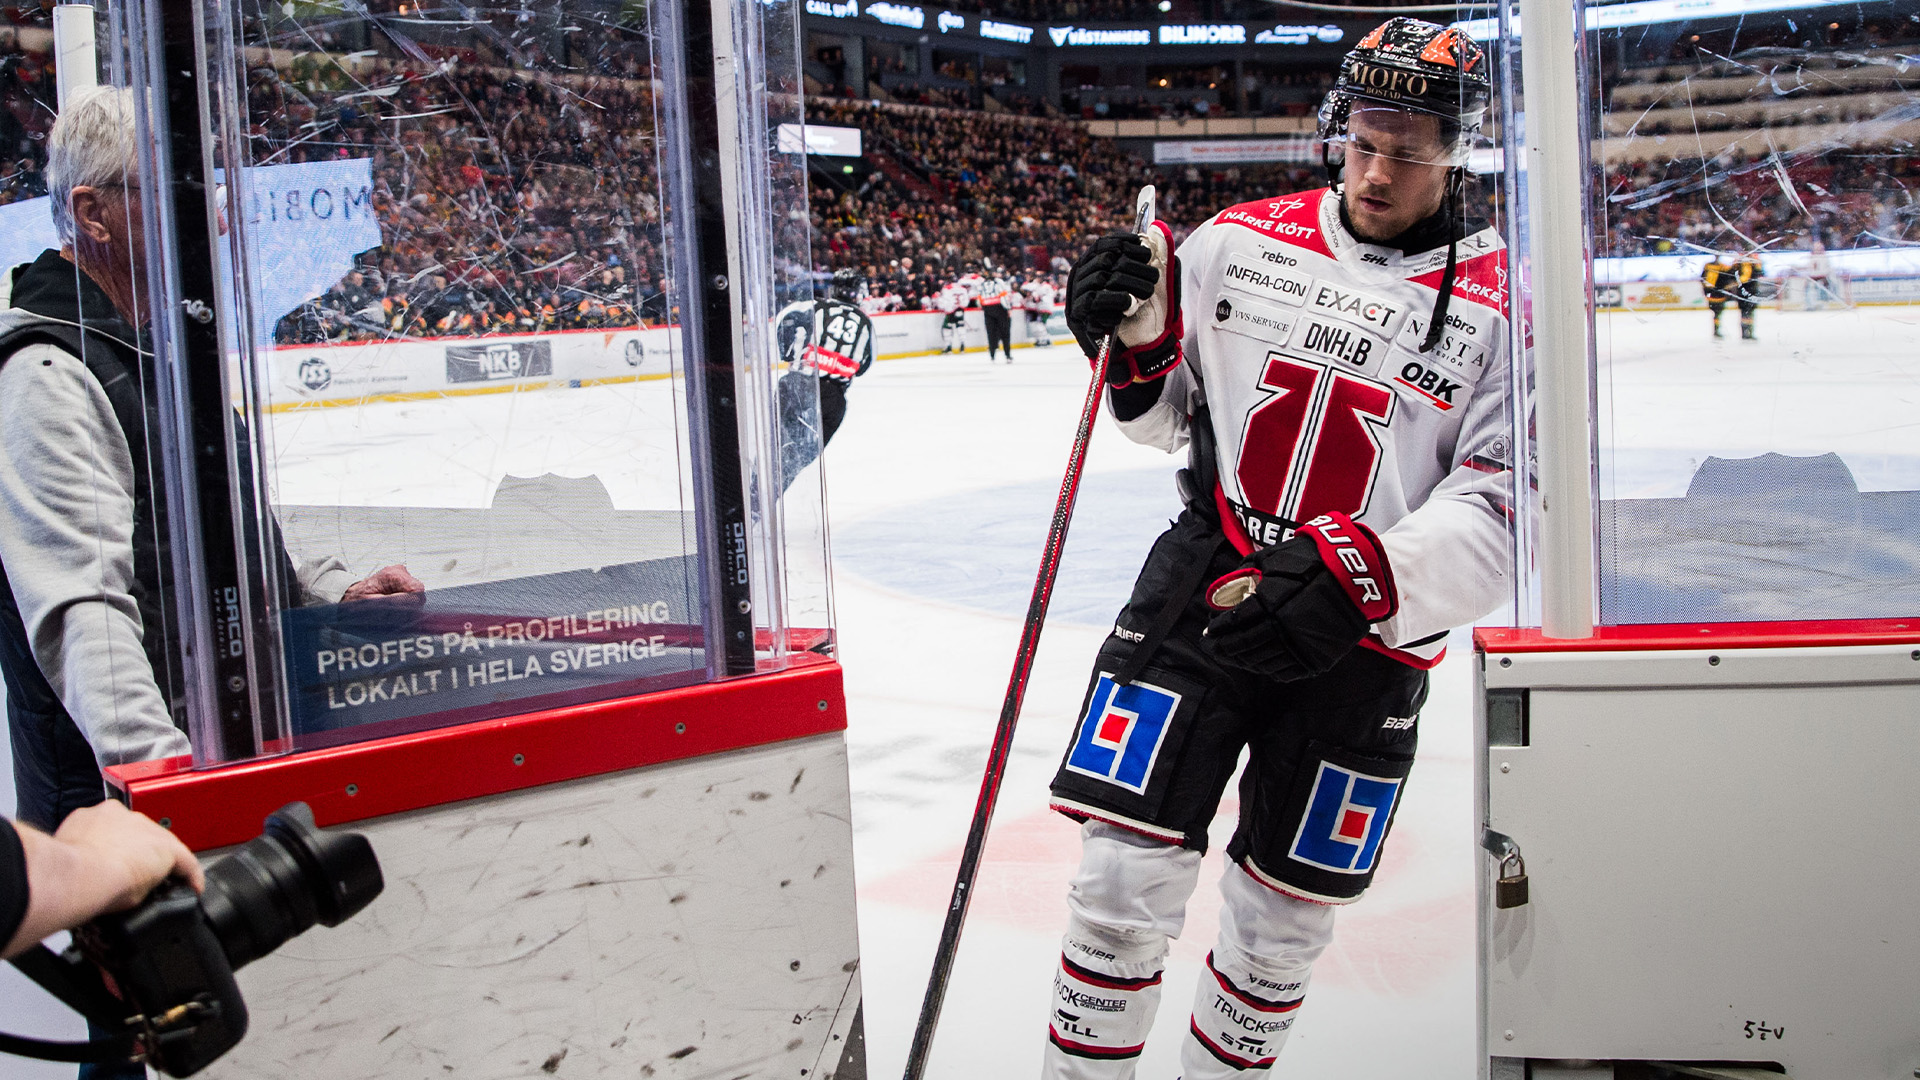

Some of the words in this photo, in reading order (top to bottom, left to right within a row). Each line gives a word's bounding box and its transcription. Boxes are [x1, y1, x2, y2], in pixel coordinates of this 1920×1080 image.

[1380, 52, 1418, 64] BAUER
[1349, 63, 1428, 96] MOFO
[1365, 86, 1401, 100] BOSTAD
[1223, 211, 1275, 231] NÄRKE
[1275, 221, 1316, 240] KÖTT
[1360, 253, 1389, 267] SHL
[1226, 263, 1307, 297] INFRA-CON
[1235, 310, 1250, 321] VVS
[1251, 315, 1290, 333] SERVICE
[1315, 286, 1396, 327] EXACT
[826, 315, 859, 345] 43
[1445, 315, 1477, 335] ebro
[1407, 319, 1485, 368] NSTA
[479, 350, 521, 373] NKB
[1401, 361, 1463, 404] OBK
[733, 522, 748, 585] DACO
[1305, 515, 1382, 605] AUER
[224, 586, 243, 657] DACO
[317, 635, 435, 675] PROFFS
[442, 621, 480, 656] PÅ
[487, 600, 670, 649] PROFILERING
[1115, 624, 1146, 644] AUER
[328, 669, 442, 710] LOKALT
[451, 667, 458, 690] I
[467, 654, 544, 688] HELA
[550, 634, 667, 674] SVERIGE
[1080, 993, 1127, 1008] CENTER
[1214, 994, 1267, 1034] TRUCK
